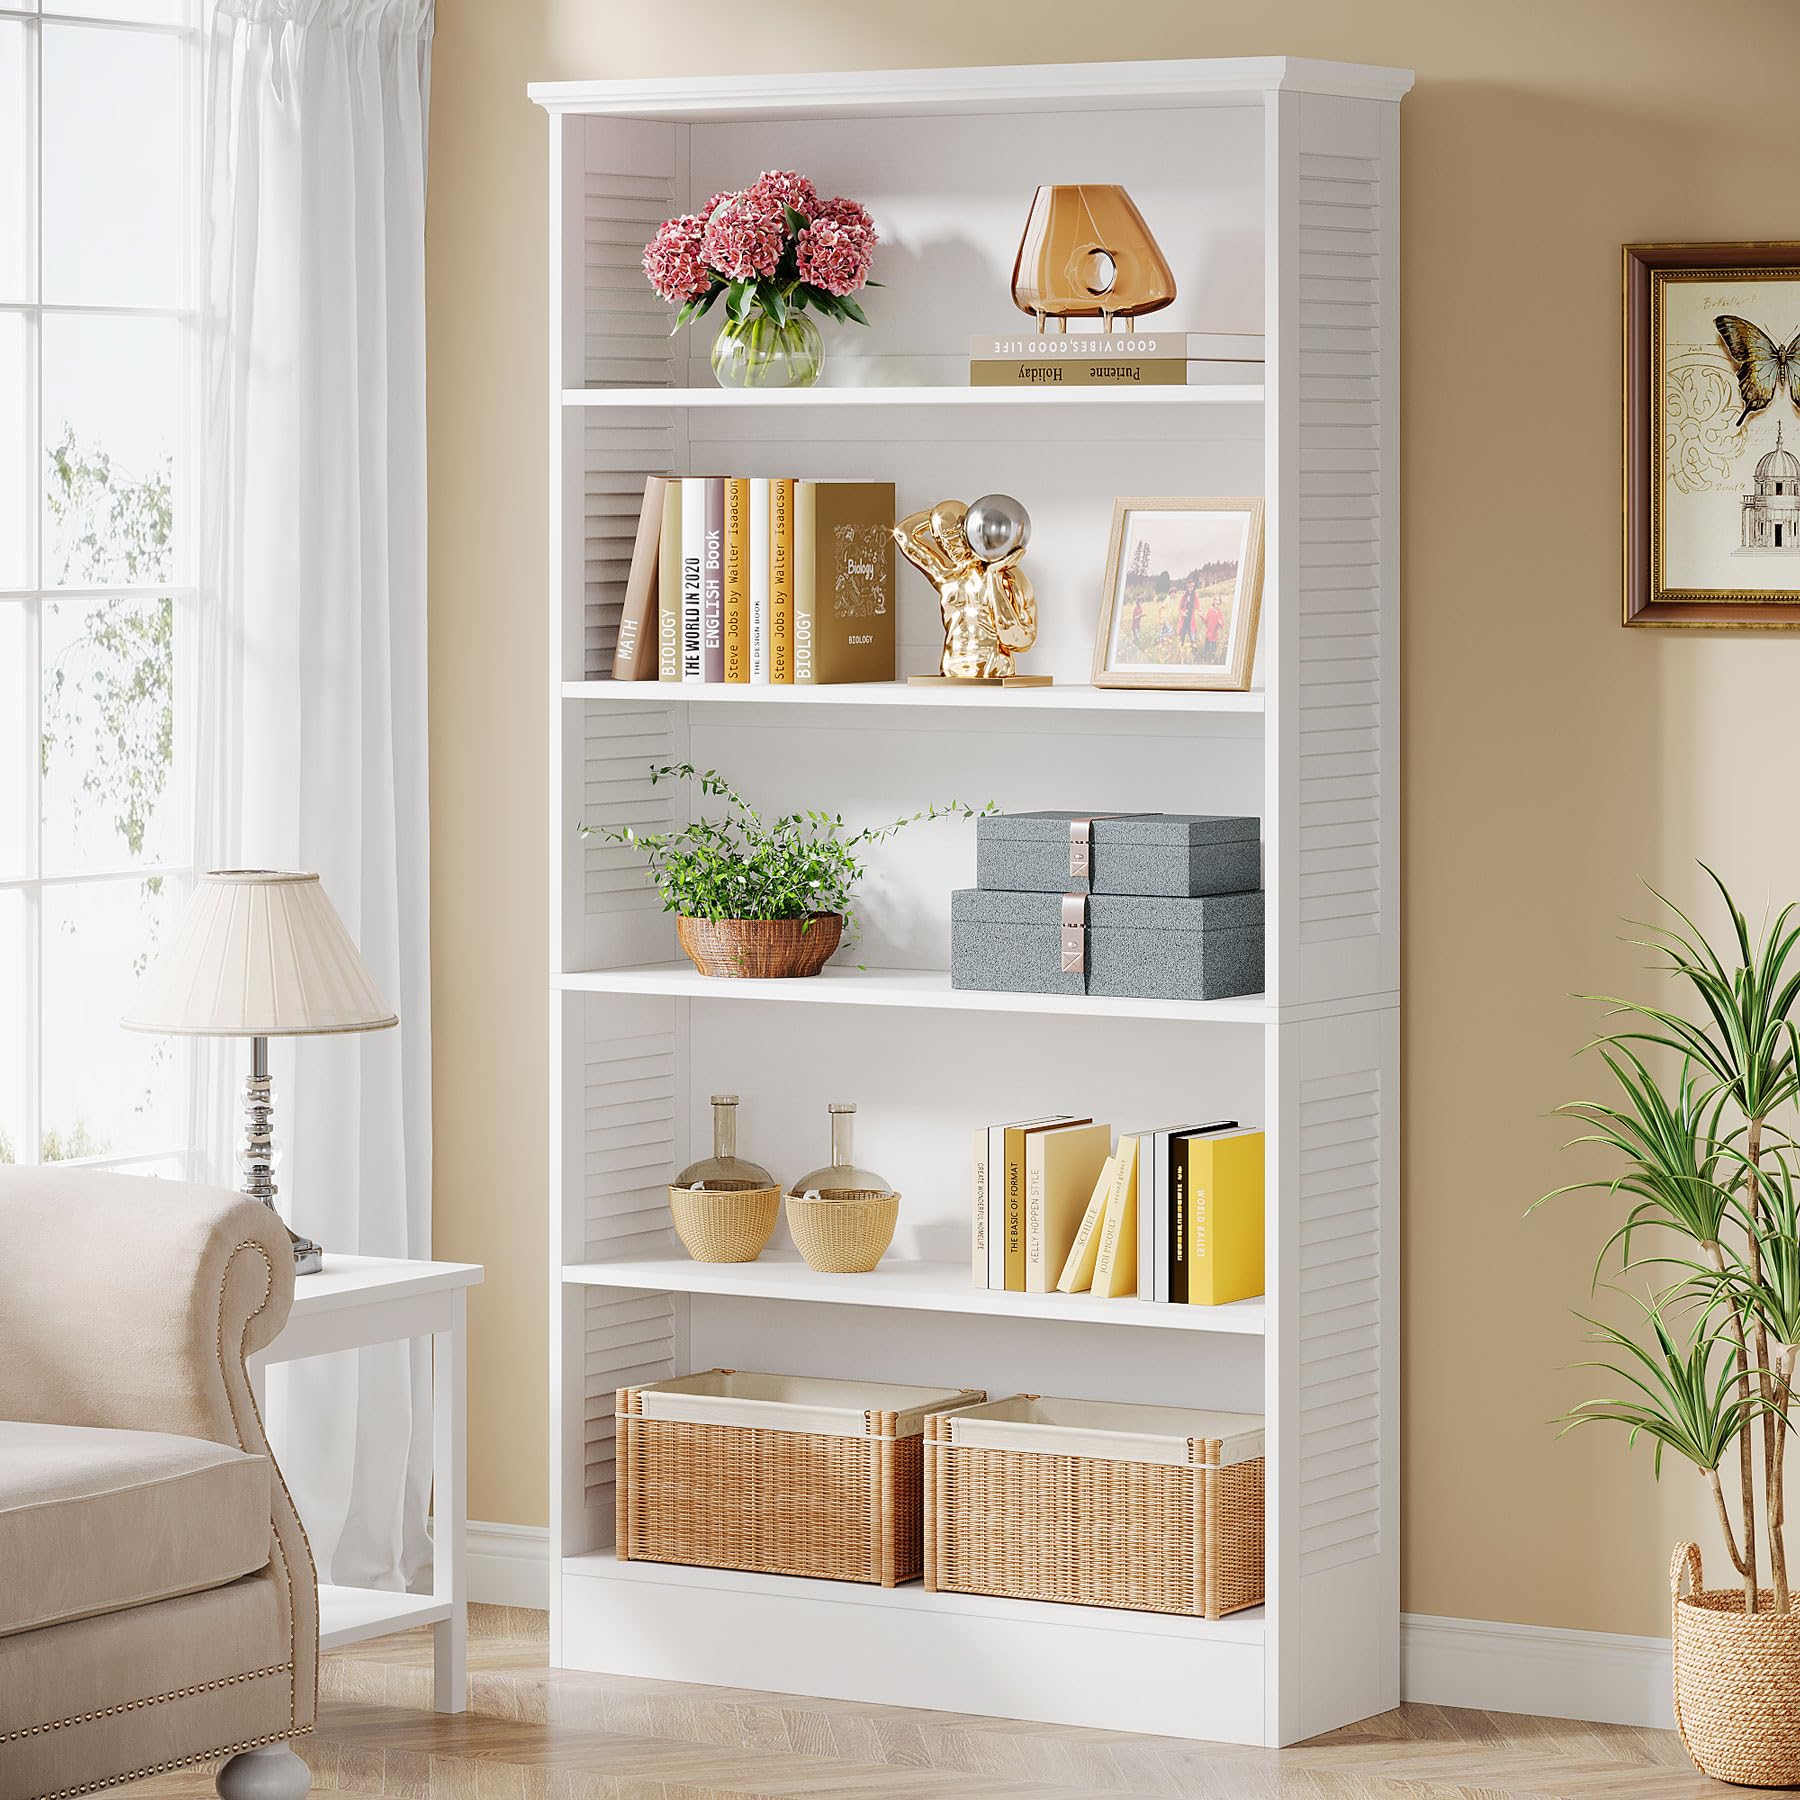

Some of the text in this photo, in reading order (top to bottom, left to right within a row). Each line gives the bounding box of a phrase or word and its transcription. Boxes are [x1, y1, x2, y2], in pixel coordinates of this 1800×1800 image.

[994, 340, 1023, 353] LIFE
[1018, 364, 1141, 382] Purienne Holiday
[1116, 339, 1157, 352] GOOD
[705, 529, 720, 649] ENGLISH Book
[727, 481, 742, 679] Steve Jobs by Walter Isaacson
[774, 481, 788, 680] Steve Jobs by Walter Isaacson
[847, 559, 875, 581] Biology
[618, 619, 639, 660] MATH
[661, 609, 676, 677] BIOLOGY
[685, 557, 700, 677] THE WORLD IN 2020
[797, 610, 811, 679] BIOLOGY
[848, 635, 874, 645] BIOLOGY
[977, 1162, 985, 1184] CREATE
[1010, 1162, 1019, 1253] THE BASIC OF FORMAT
[1031, 1169, 1040, 1264] KELLY HOPPEN STYLE
